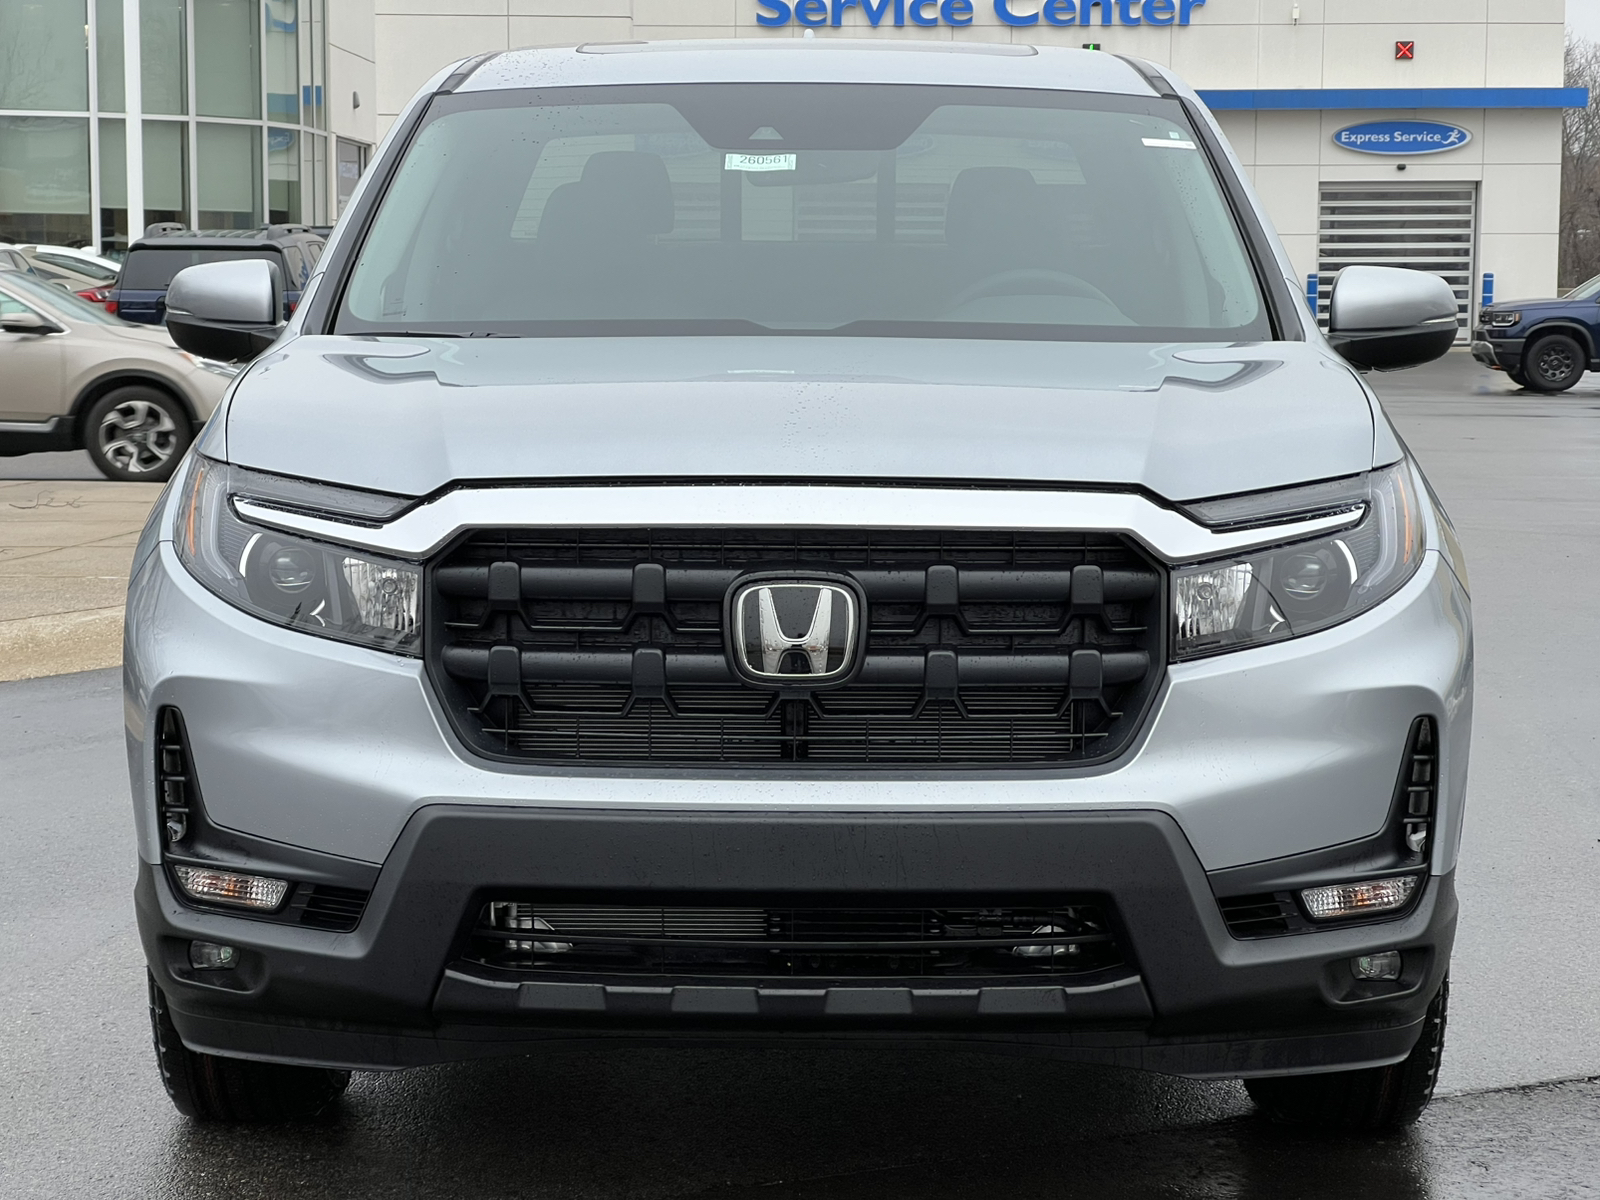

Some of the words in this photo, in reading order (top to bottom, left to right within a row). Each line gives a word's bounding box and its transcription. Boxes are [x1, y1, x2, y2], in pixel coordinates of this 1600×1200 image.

[756, 0, 974, 27] Service
[993, 0, 1206, 27] Center
[1341, 131, 1390, 145] Express
[1394, 131, 1441, 142] Service
[739, 155, 788, 165] 260561
